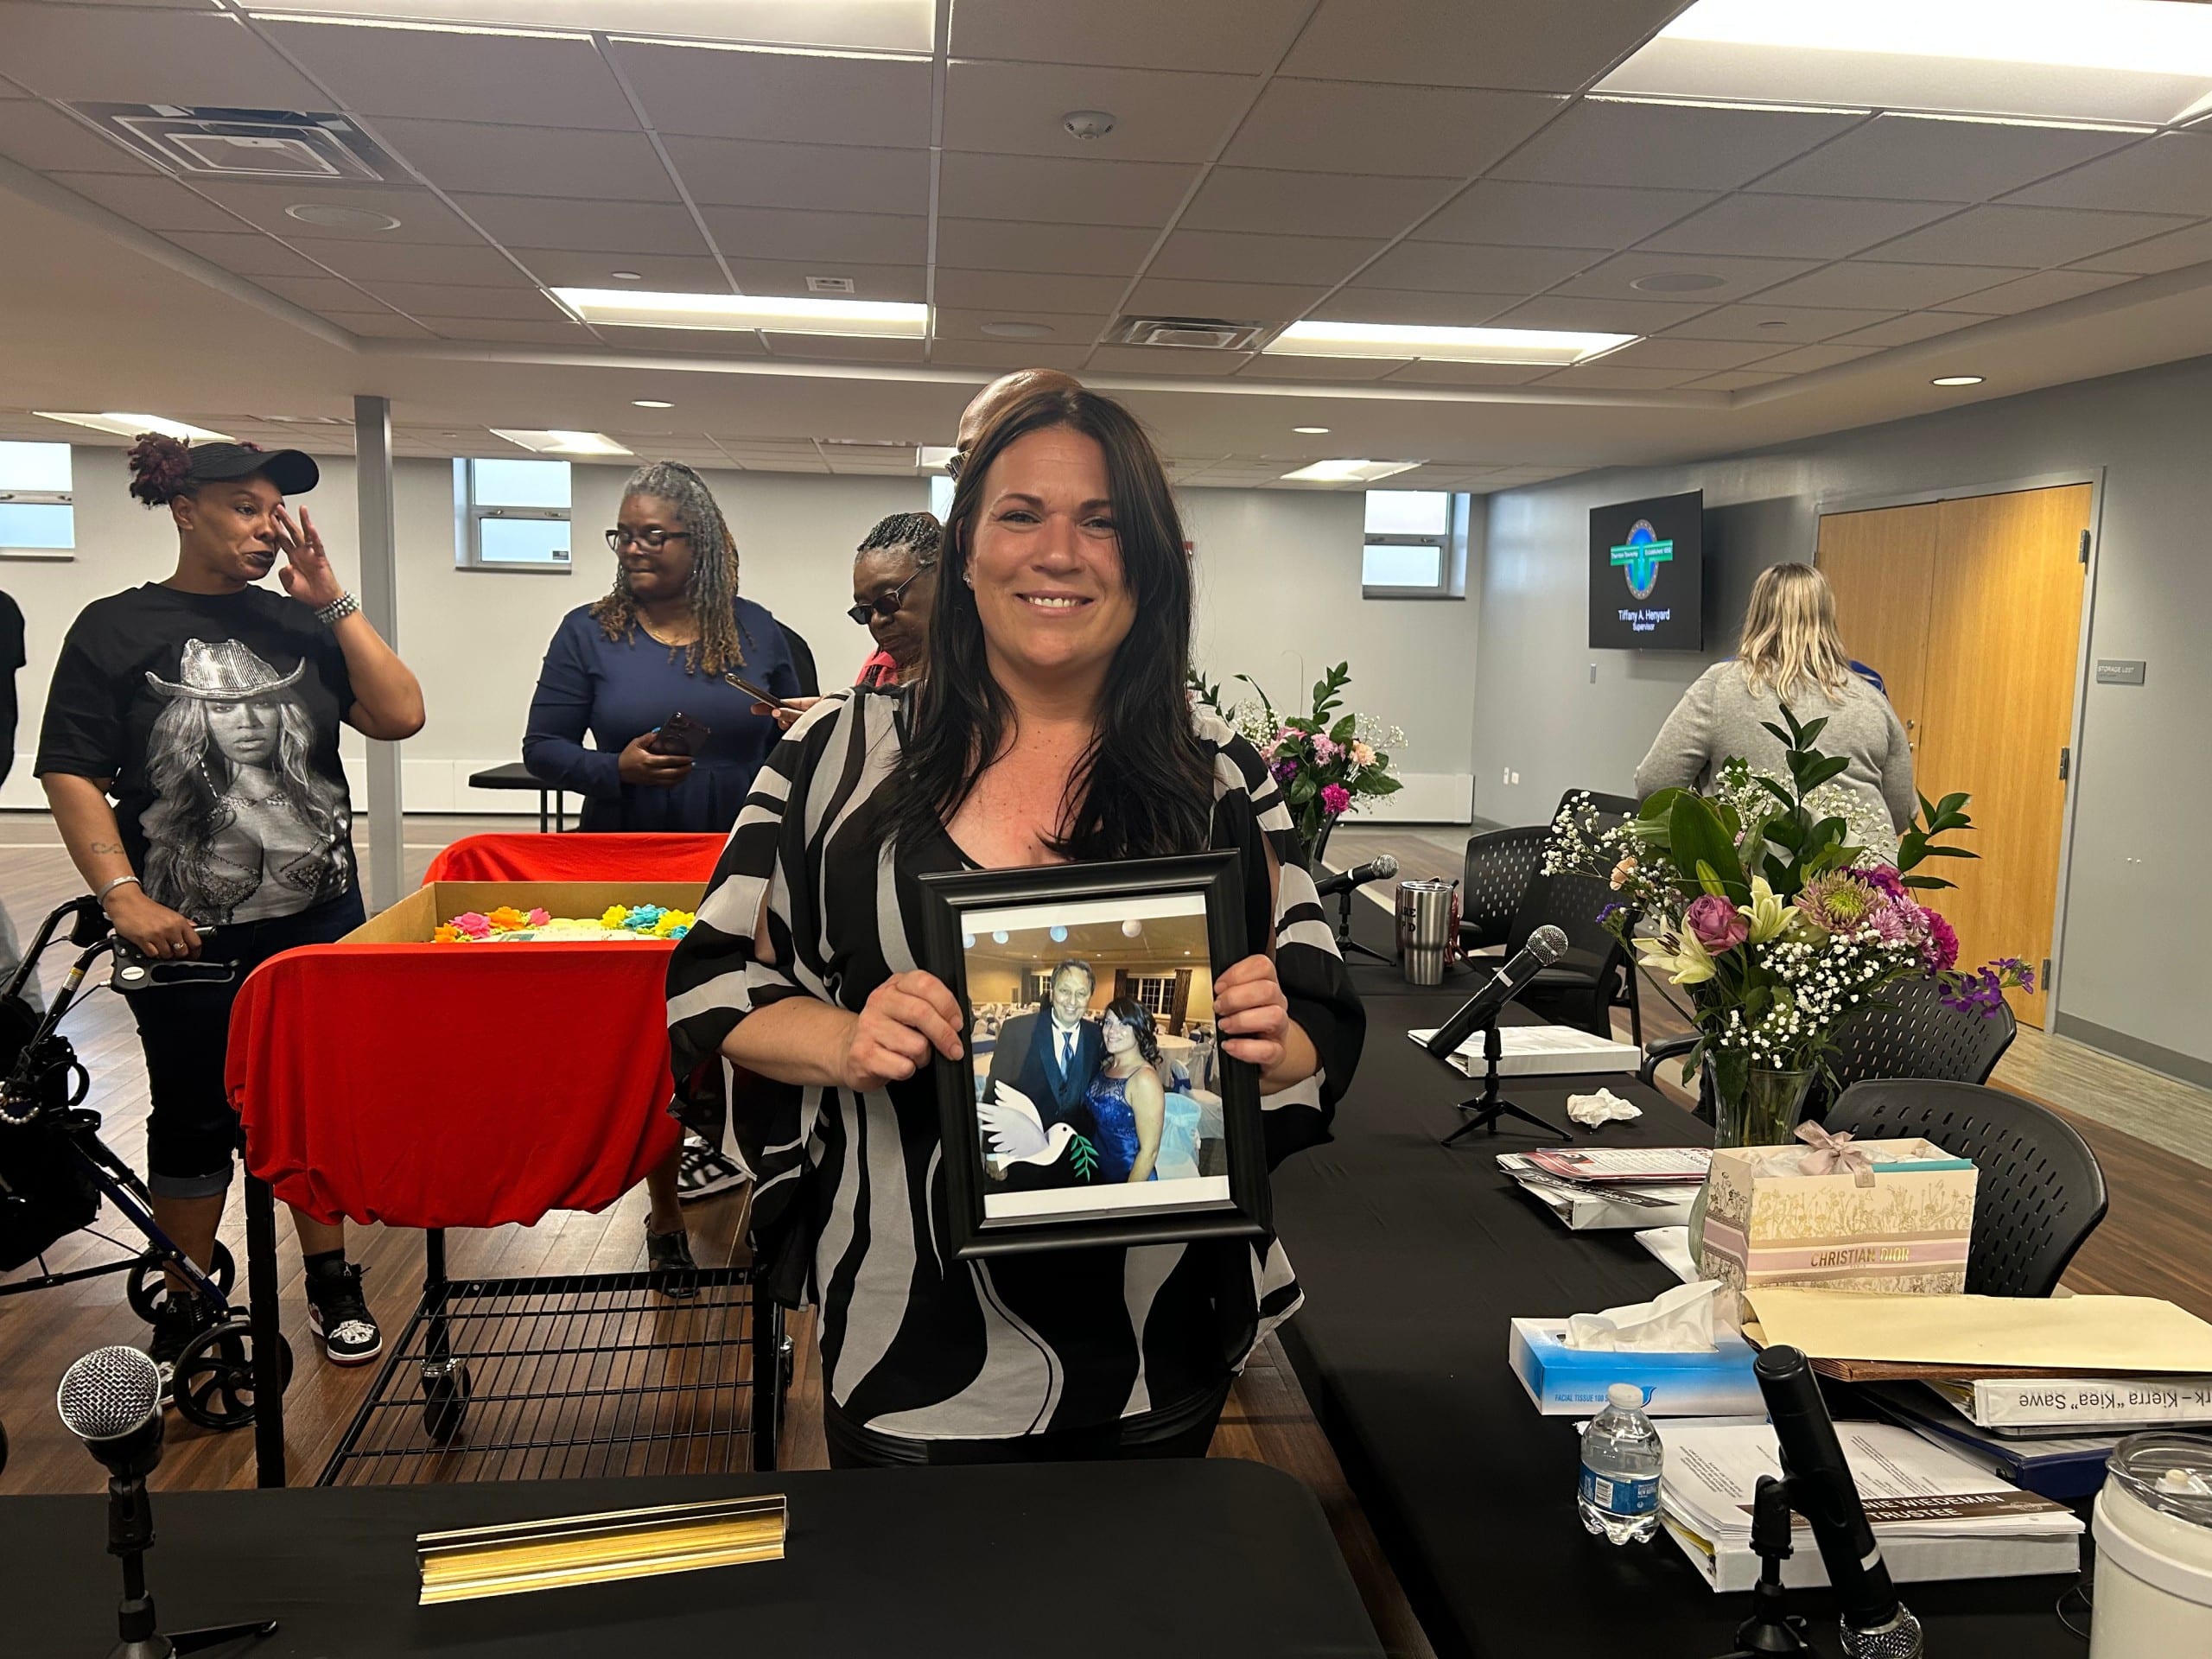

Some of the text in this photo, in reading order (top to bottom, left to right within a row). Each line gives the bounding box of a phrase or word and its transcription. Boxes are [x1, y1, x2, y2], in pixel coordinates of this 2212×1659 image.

[1618, 609, 1637, 622] Tiffany
[1645, 608, 1669, 622] Henyard
[1810, 1247, 1910, 1267] CHRISTIAN DIOR
[1554, 1394, 1573, 1402] FACIAL
[1574, 1394, 1593, 1402] TISSUE
[2018, 1394, 2066, 1410] Sawe
[2129, 1391, 2177, 1408] Kierra
[1861, 1495, 2005, 1509] NIE WIEDEMAN
[1866, 1508, 1964, 1520] TRUSTEE
